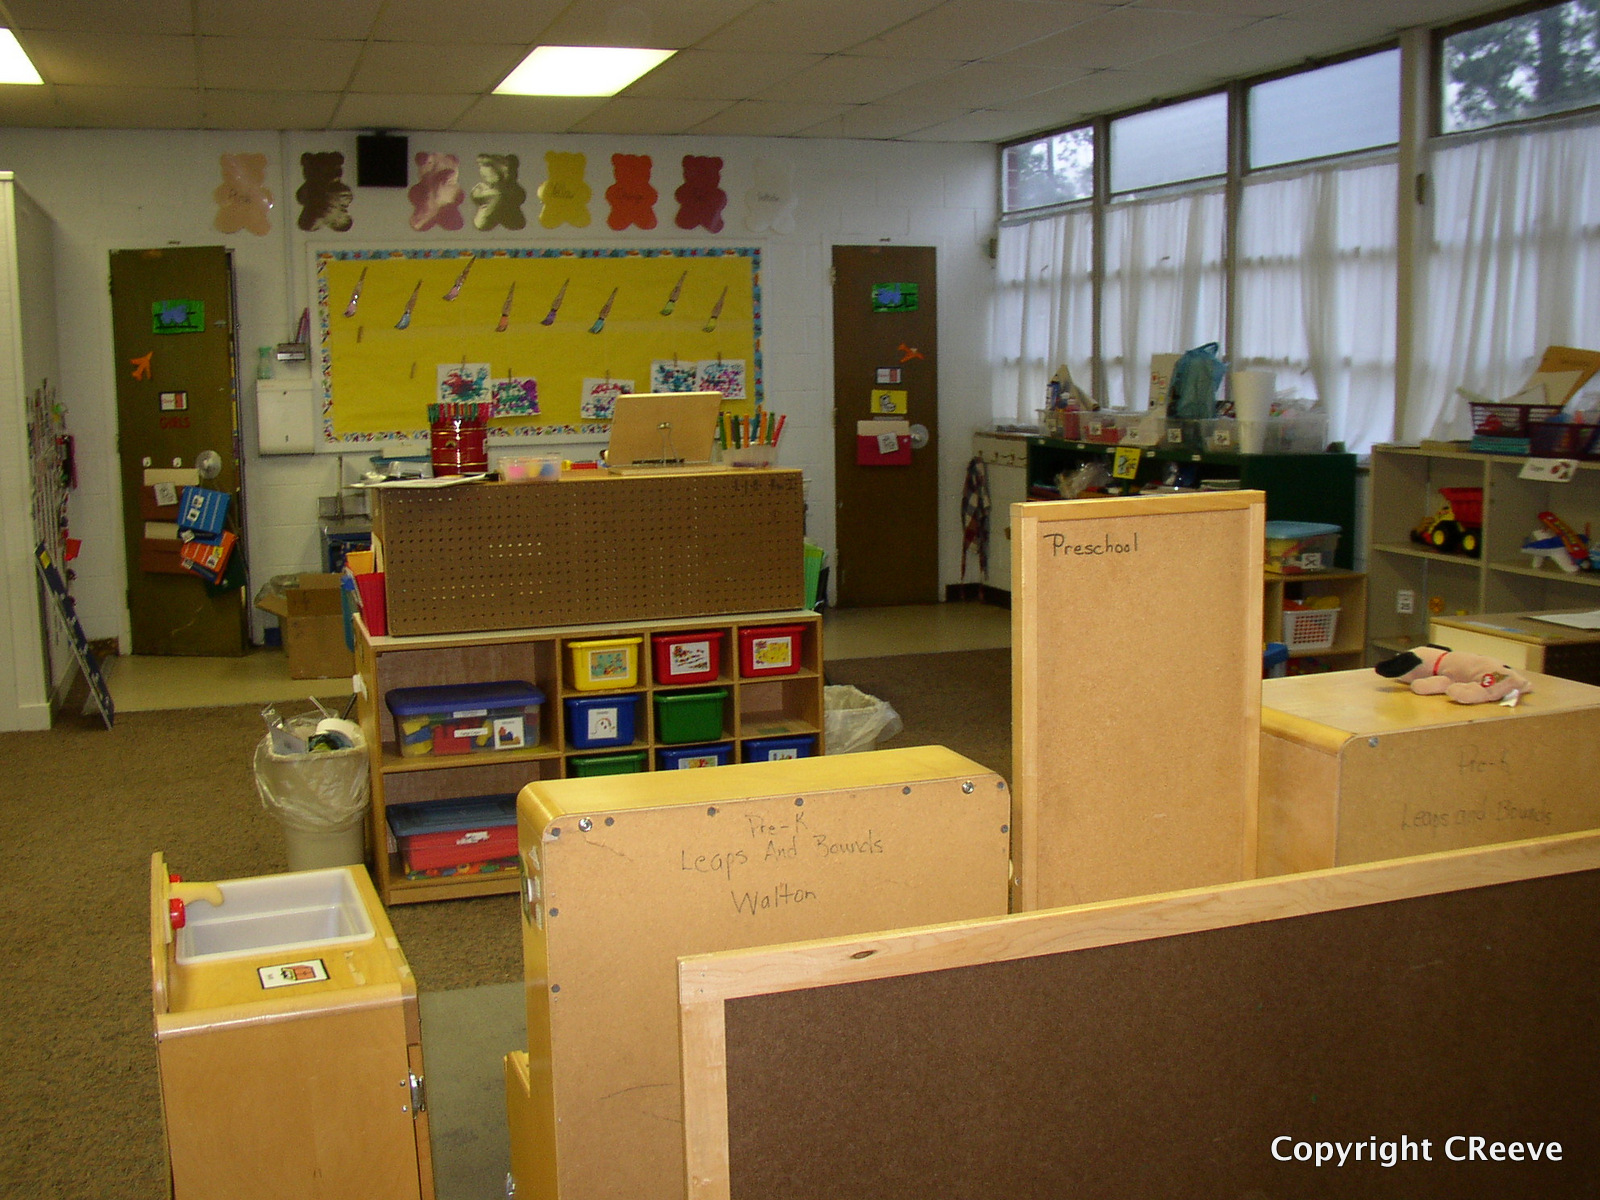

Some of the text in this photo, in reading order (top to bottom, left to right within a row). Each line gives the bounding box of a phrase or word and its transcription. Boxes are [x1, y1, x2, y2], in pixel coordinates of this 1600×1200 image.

[1043, 532, 1138, 556] Preschool
[745, 811, 808, 838] Pre-K
[681, 829, 884, 880] Leaps And Bounds
[730, 883, 817, 916] Walton
